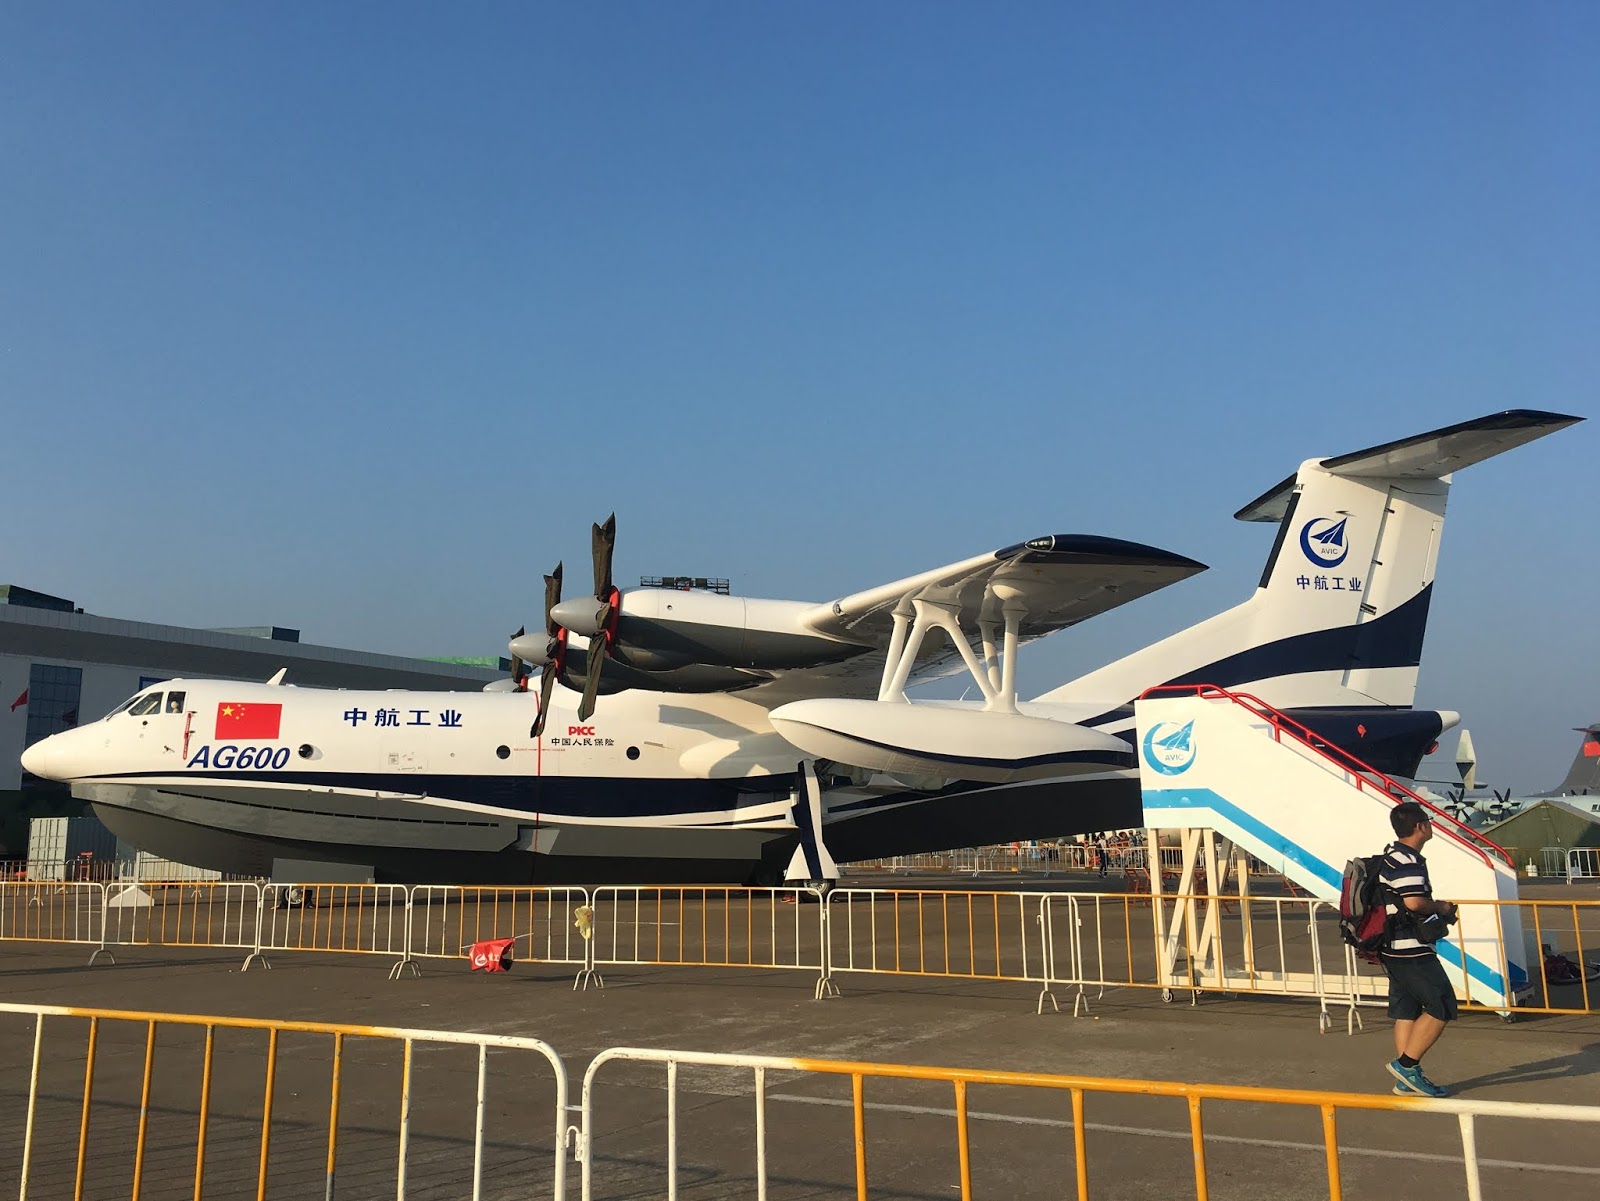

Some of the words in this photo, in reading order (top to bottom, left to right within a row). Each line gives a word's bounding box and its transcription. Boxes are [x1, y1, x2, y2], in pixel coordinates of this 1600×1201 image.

[1296, 575, 1362, 592] 中航工业
[344, 707, 463, 727] 中航工业
[568, 726, 596, 736] PICC
[551, 737, 615, 747] 中国人民保险
[187, 745, 291, 769] AG600
